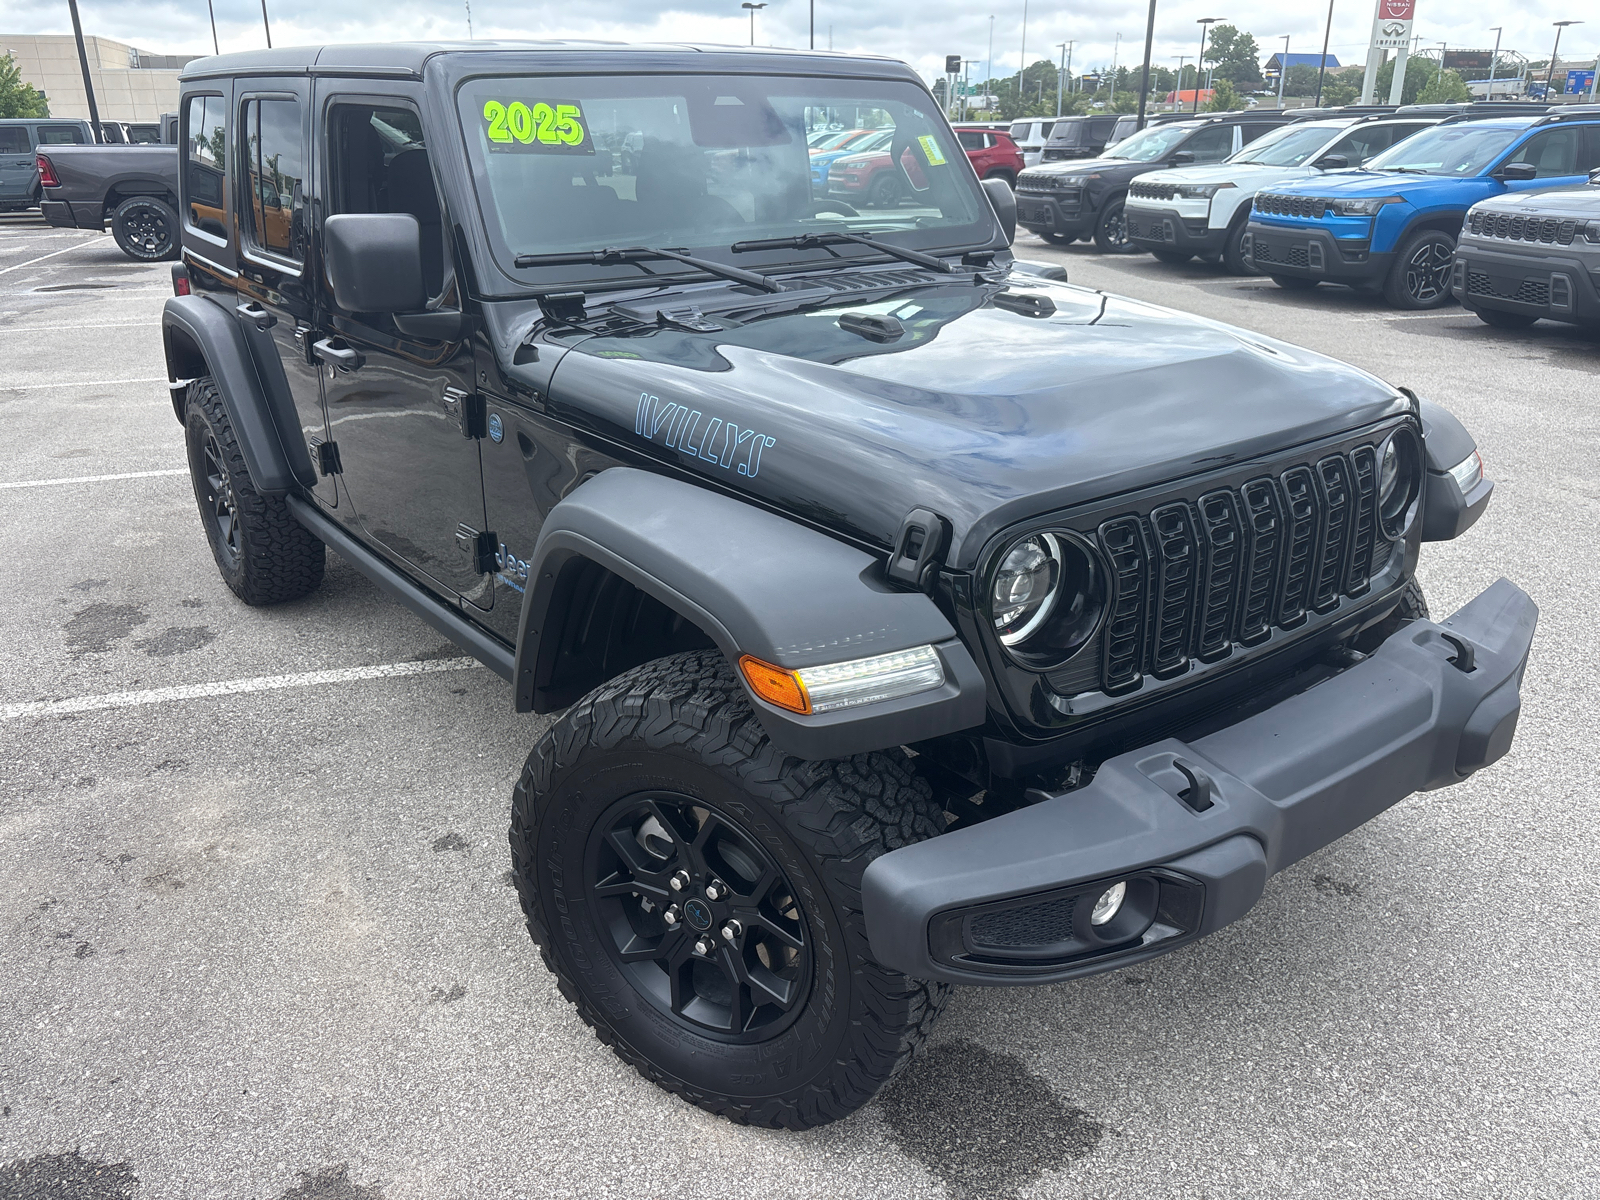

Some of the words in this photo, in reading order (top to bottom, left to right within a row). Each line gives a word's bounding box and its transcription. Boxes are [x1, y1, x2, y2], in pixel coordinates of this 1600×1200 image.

[483, 100, 584, 146] 2025
[635, 392, 776, 478] WILLYS
[547, 788, 633, 1021] BFGoodrich
